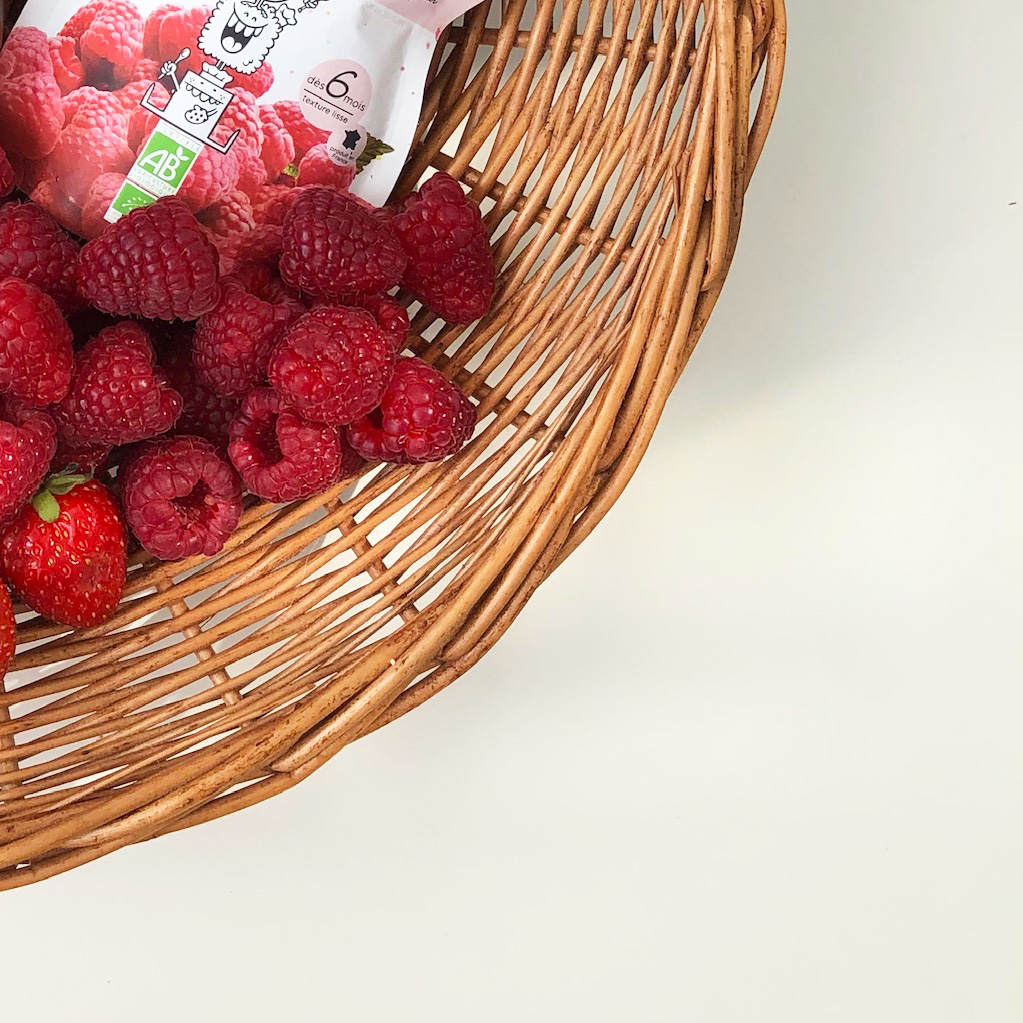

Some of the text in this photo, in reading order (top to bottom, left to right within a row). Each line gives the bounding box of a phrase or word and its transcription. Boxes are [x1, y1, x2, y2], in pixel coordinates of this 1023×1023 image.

[306, 70, 366, 112] dès 6 mois
[302, 95, 349, 124] texture lisse
[140, 149, 181, 182] AB
